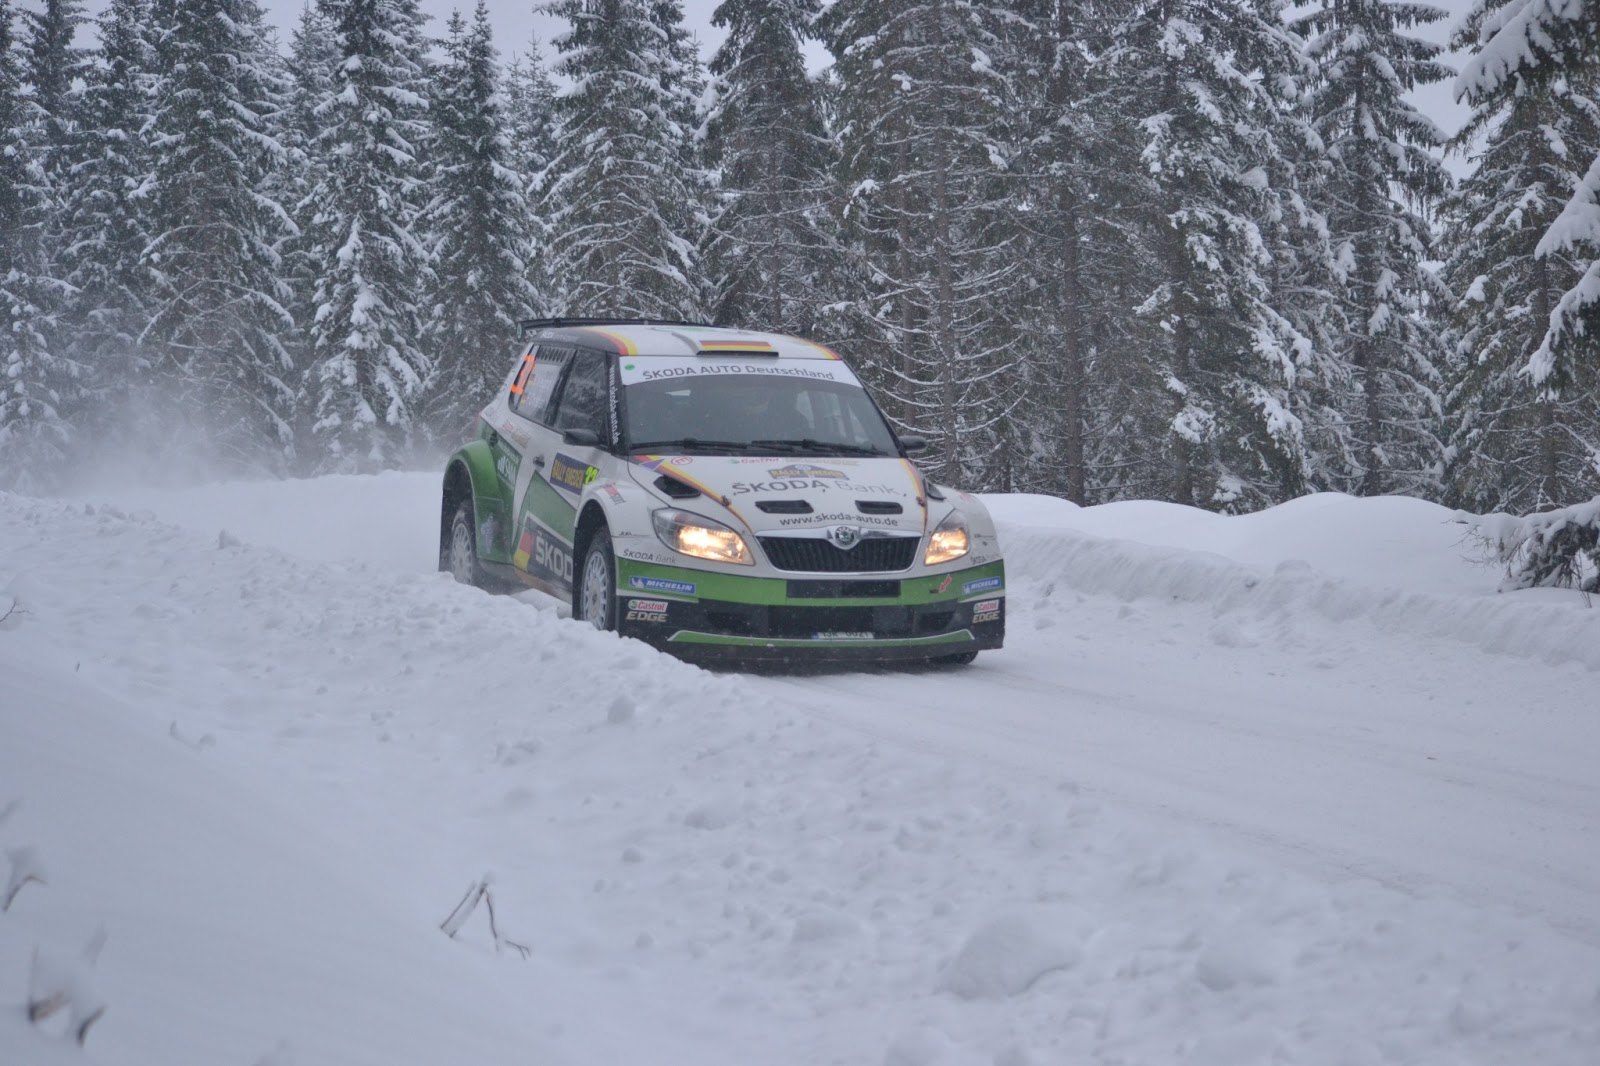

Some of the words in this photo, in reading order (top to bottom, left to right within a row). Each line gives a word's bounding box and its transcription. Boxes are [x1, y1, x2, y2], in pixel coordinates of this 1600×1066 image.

[700, 365, 742, 375] AUTO
[745, 364, 835, 380] Deutschland
[834, 480, 902, 495] Bank
[779, 512, 899, 527] www.skoda-auto.de
[622, 548, 654, 561] ŠKODA
[655, 554, 676, 564] Bank
[646, 580, 693, 591] MICHELIN
[970, 579, 999, 589] MICHELIN
[637, 601, 666, 611] Castrol
[625, 611, 669, 623] EDGE
[972, 610, 1000, 624] EDGE
